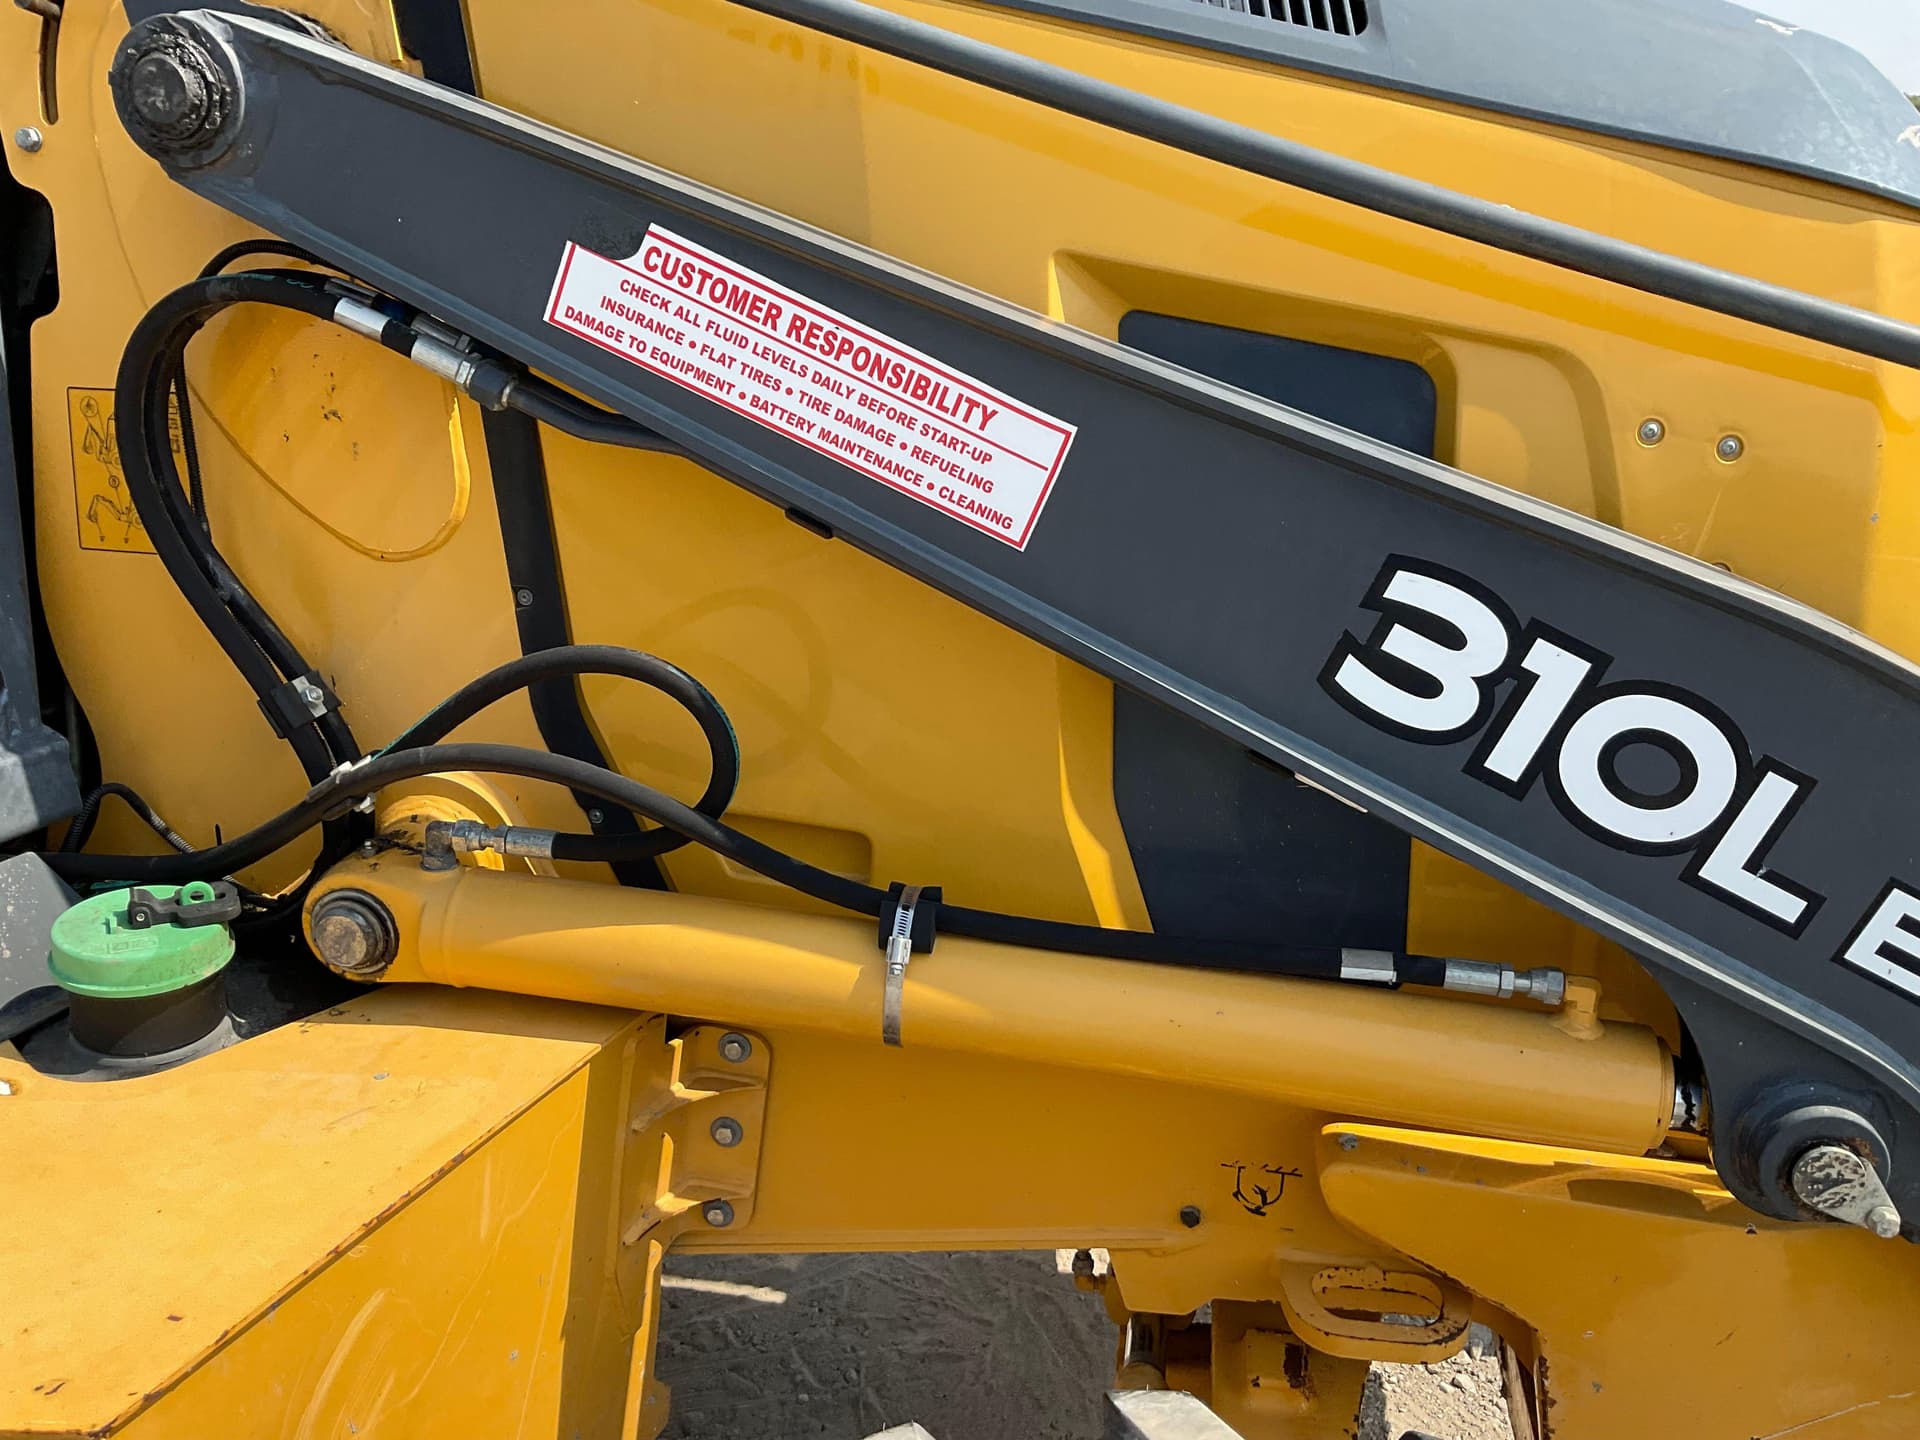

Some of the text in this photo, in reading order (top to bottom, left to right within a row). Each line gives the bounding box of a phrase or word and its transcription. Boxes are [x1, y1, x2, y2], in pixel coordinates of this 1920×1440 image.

[565, 306, 1014, 530] DAMAGE TO EQUIPMENT BATTERY MAINTENANCE CLEANING
[601, 296, 993, 494] INSURANCE FLAT TIRES TIRE DAMAGE REFUELING
[620, 279, 993, 464] CHECK ALL FLUID LEVELS DAILY BEFORE START-UP
[643, 246, 998, 431] CUSTOMER RESPONSIBILITY
[1333, 569, 1809, 924] 310L
